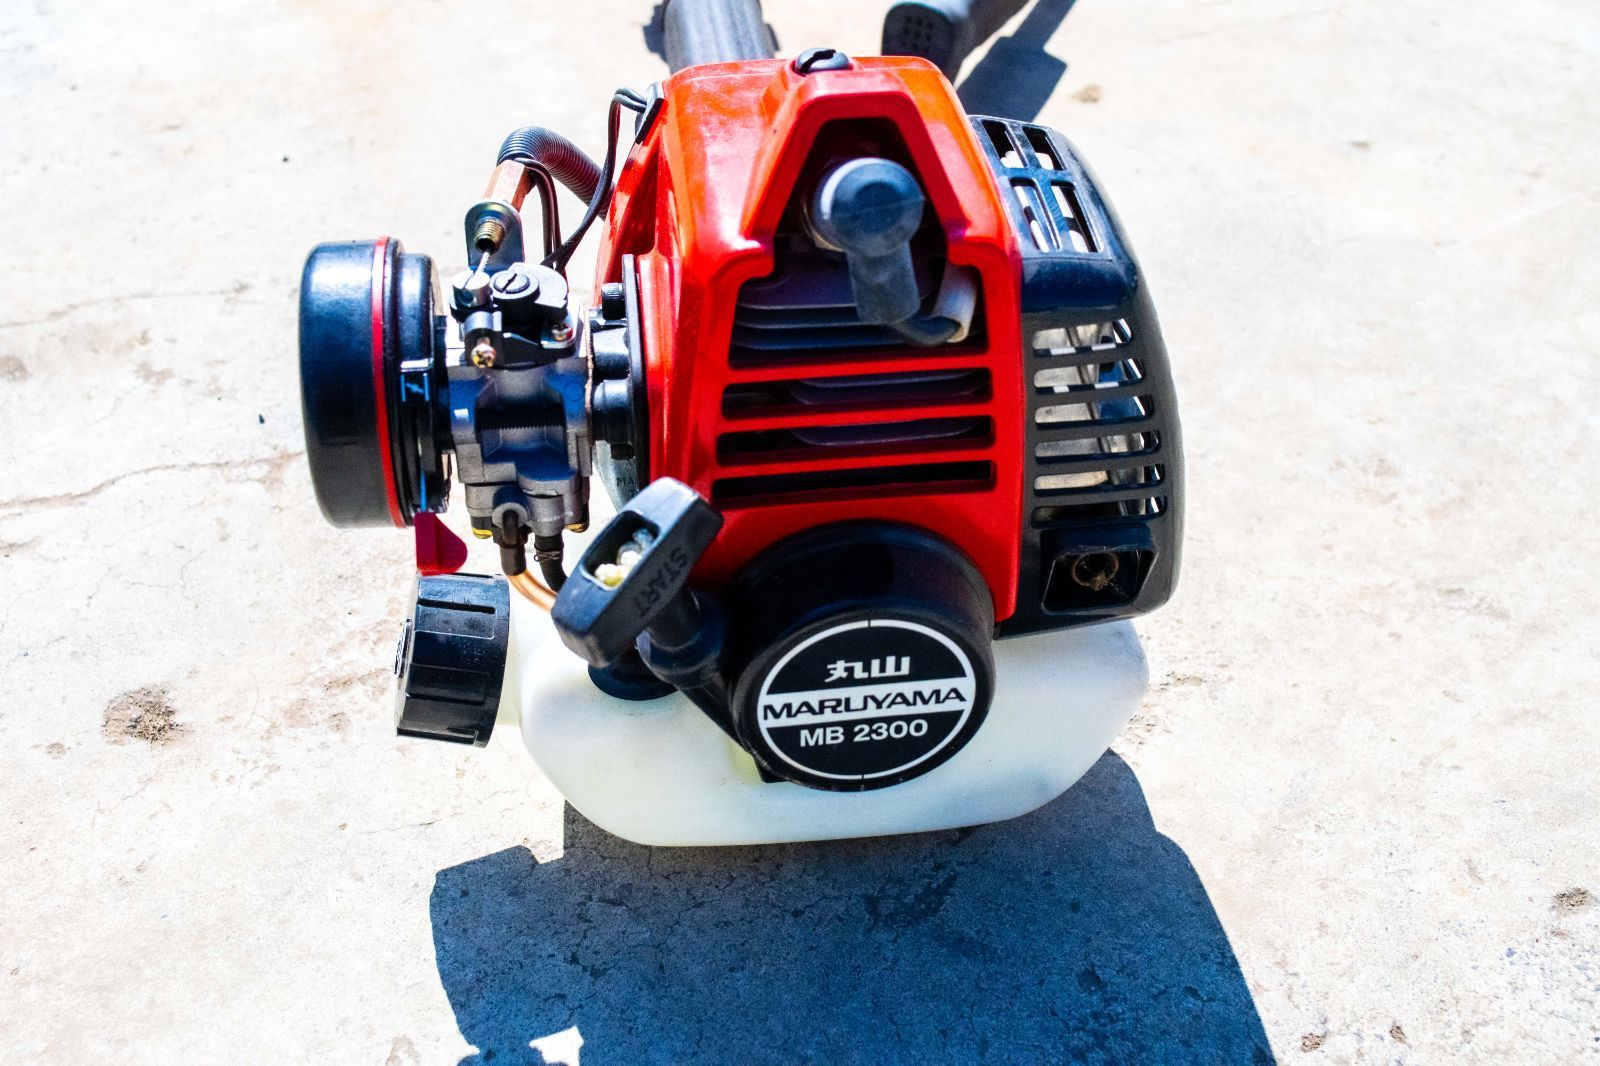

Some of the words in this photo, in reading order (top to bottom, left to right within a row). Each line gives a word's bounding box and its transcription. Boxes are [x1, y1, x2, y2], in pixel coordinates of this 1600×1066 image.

[633, 547, 688, 618] START
[824, 656, 910, 683] 丸山
[763, 687, 967, 721] MARUYAMA
[800, 726, 845, 747] MB
[853, 719, 928, 743] 2300
